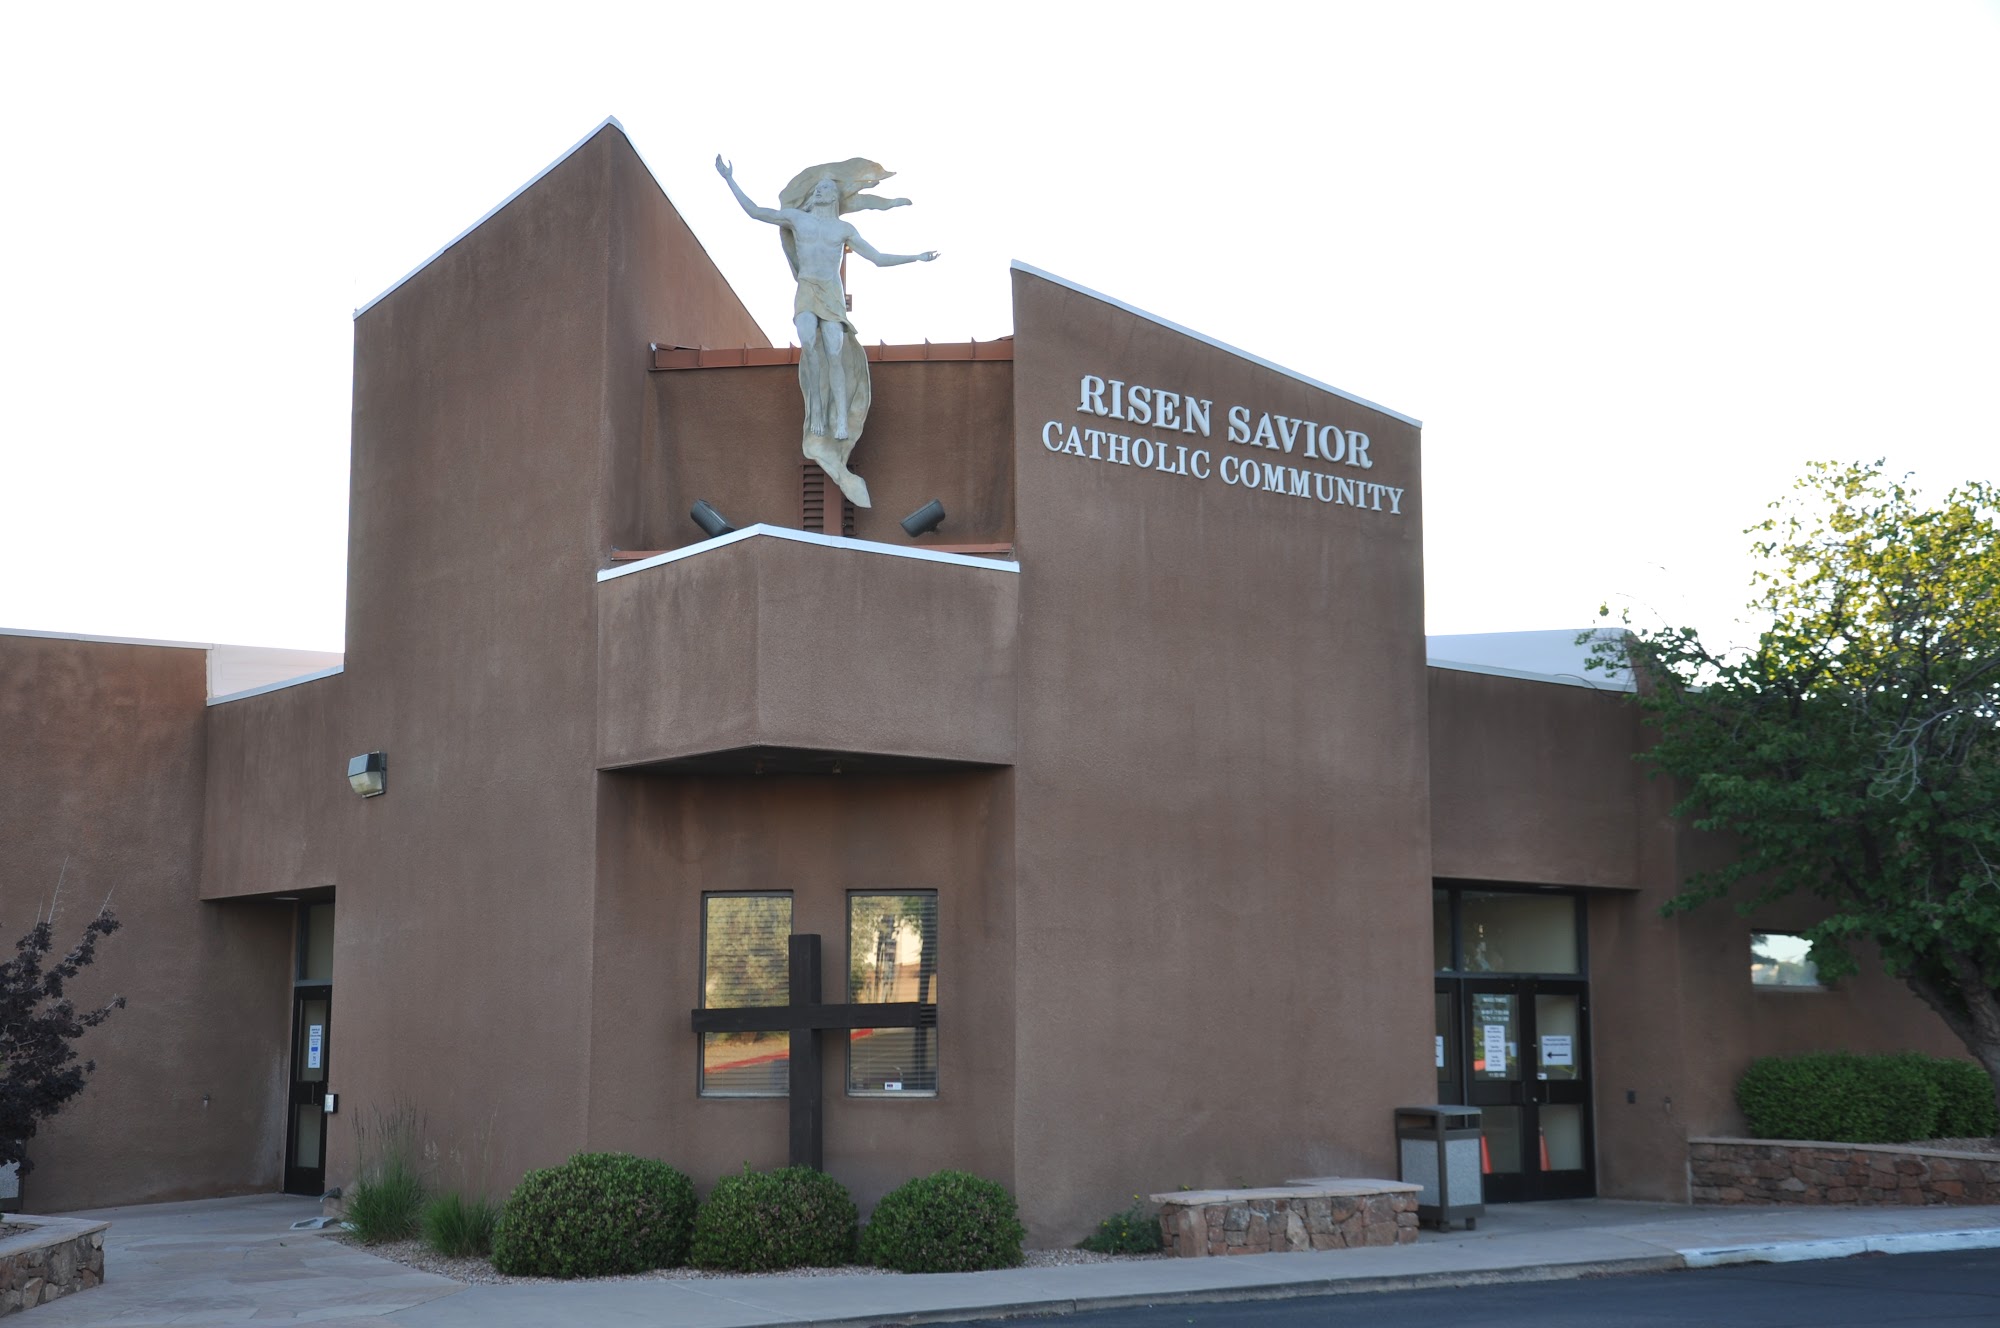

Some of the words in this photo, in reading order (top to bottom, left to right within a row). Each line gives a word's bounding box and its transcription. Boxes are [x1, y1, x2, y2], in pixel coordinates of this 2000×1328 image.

[1042, 421, 1210, 479] CATHOLIC
[1220, 456, 1404, 515] COMMUNITY
[1077, 375, 1212, 437] RISEN
[1228, 405, 1373, 469] SAVIOR
